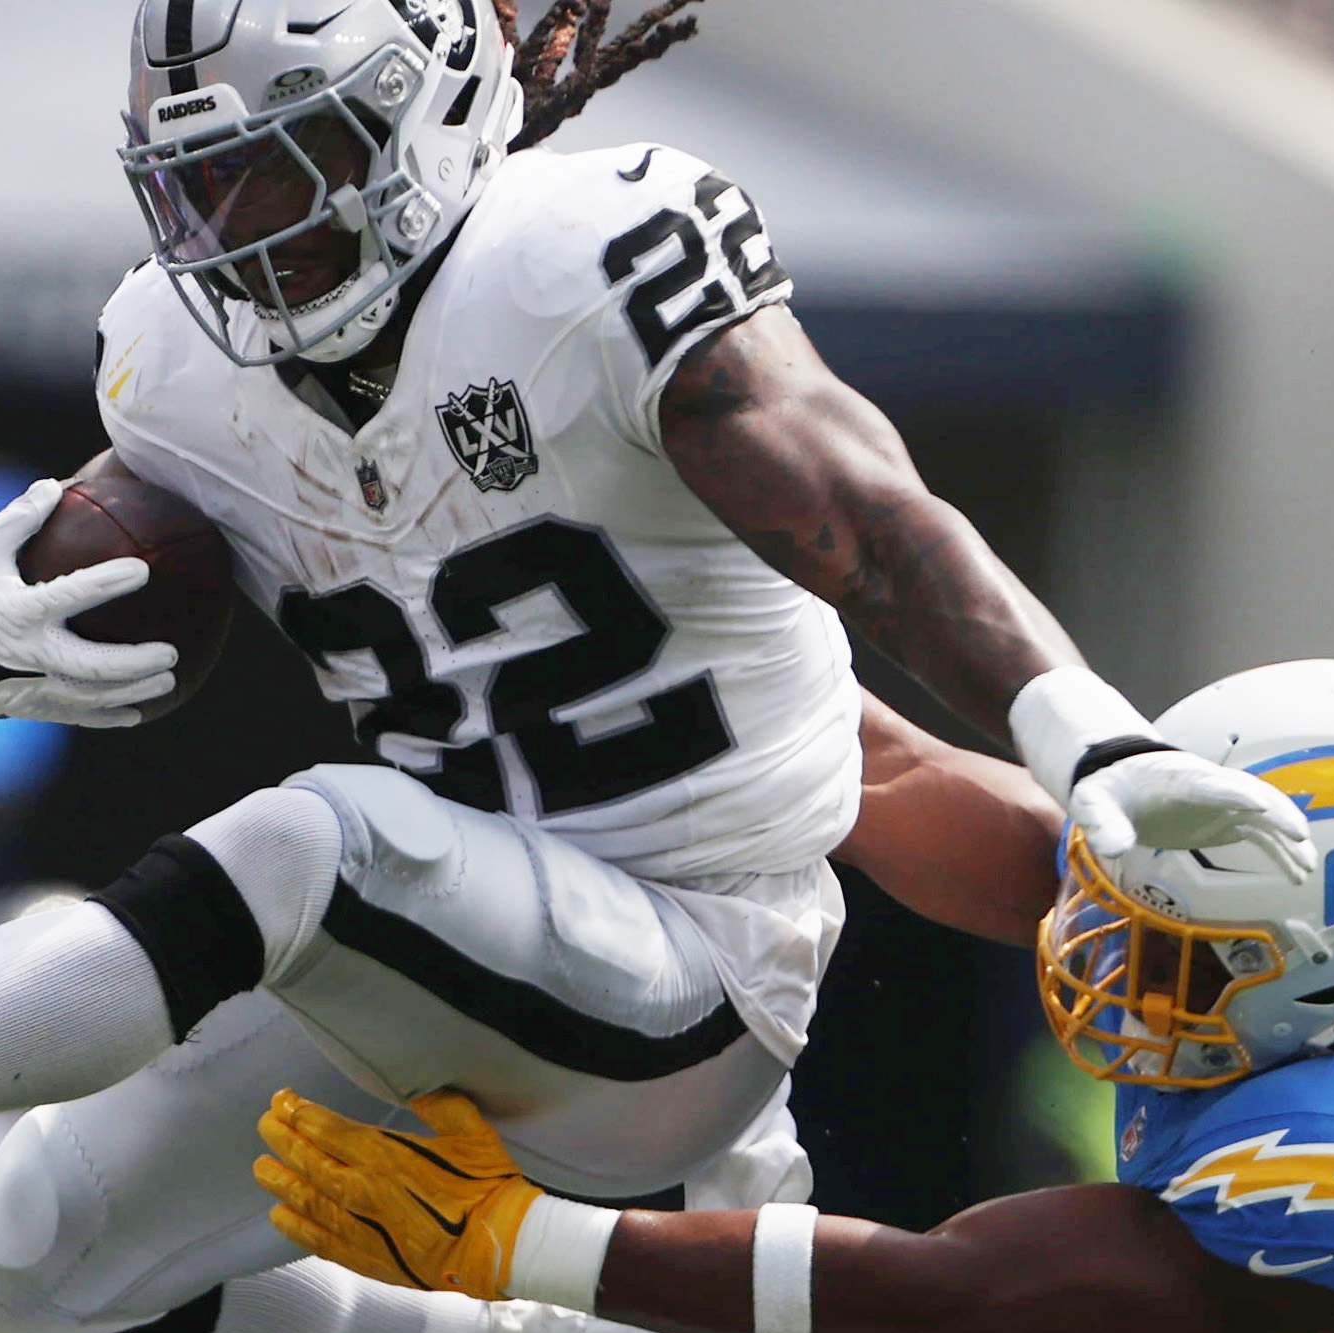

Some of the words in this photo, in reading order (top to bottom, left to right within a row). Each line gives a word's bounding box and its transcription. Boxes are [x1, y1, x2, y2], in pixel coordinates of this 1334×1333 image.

[157, 95, 217, 124] RAIDERS
[600, 172, 791, 370] 22
[454, 406, 519, 458] LXV
[275, 512, 739, 821] 22
